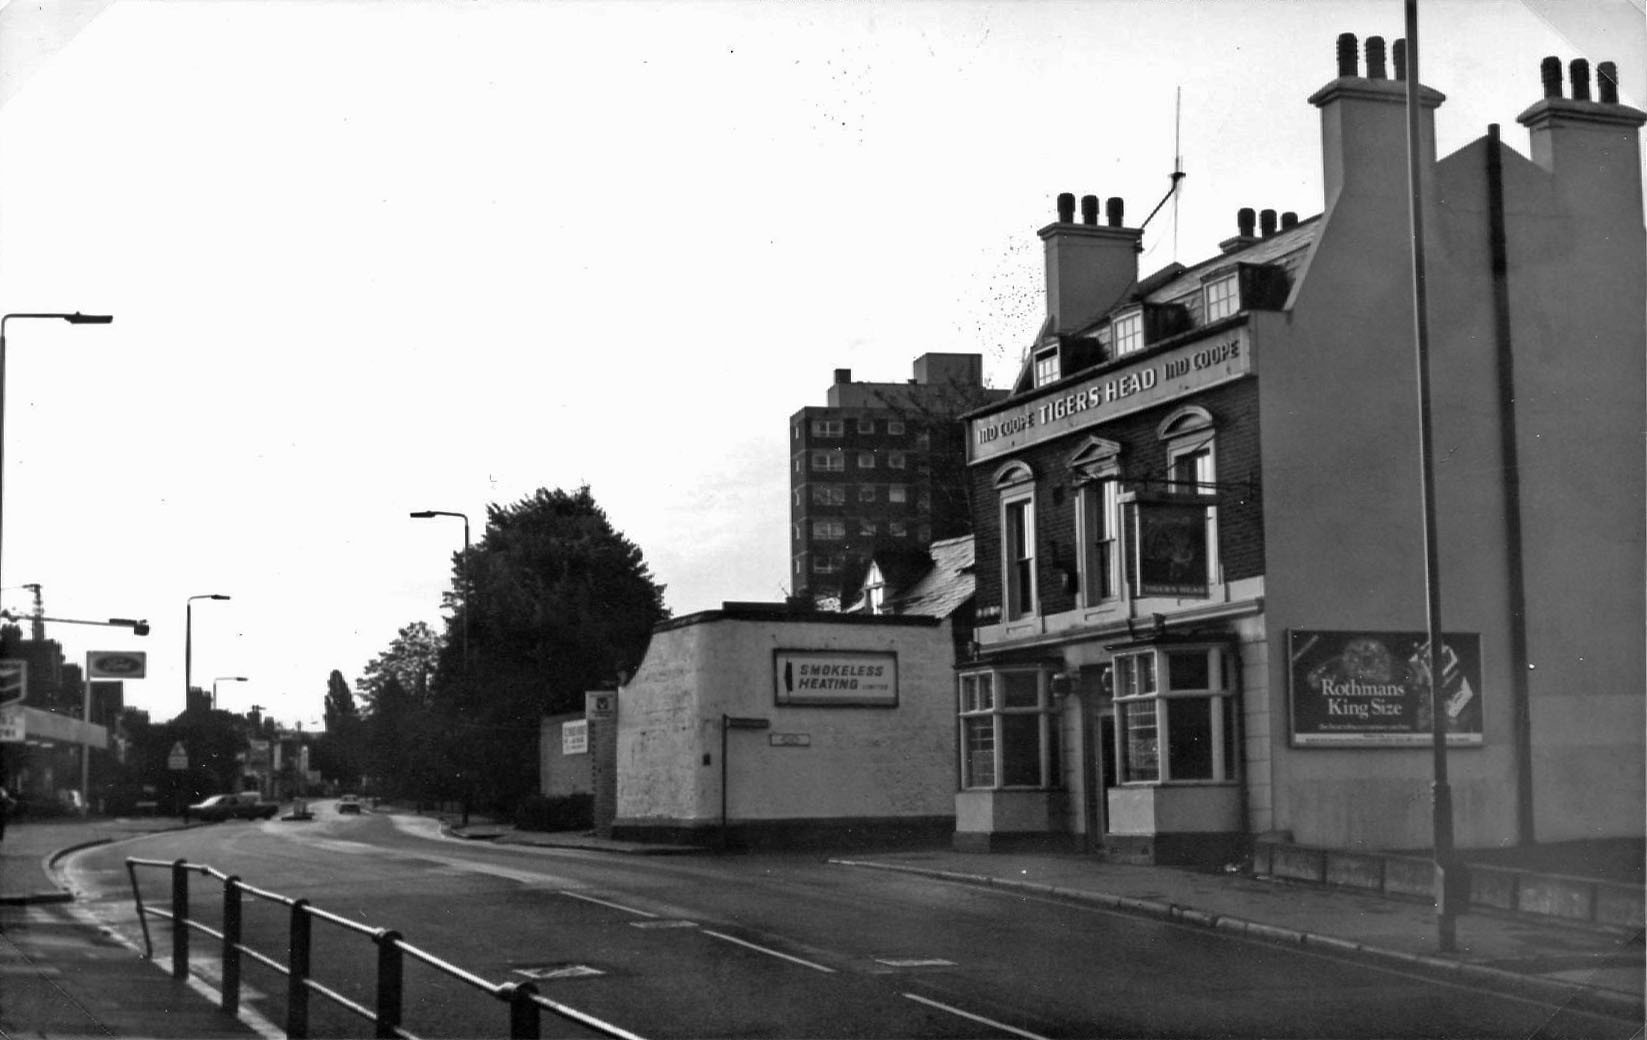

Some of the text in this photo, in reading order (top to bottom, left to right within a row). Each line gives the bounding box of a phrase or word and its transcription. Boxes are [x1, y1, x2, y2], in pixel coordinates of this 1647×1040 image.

[1000, 413, 1035, 438] COOPE
[1039, 387, 1100, 425] TIGERS
[1105, 368, 1158, 401] HEAD
[1193, 339, 1240, 371] COOPE
[799, 664, 884, 677] SMOKELESS
[798, 678, 858, 690] HEATING
[1321, 678, 1405, 697] Rothmans
[1328, 698, 1402, 719] King Size
